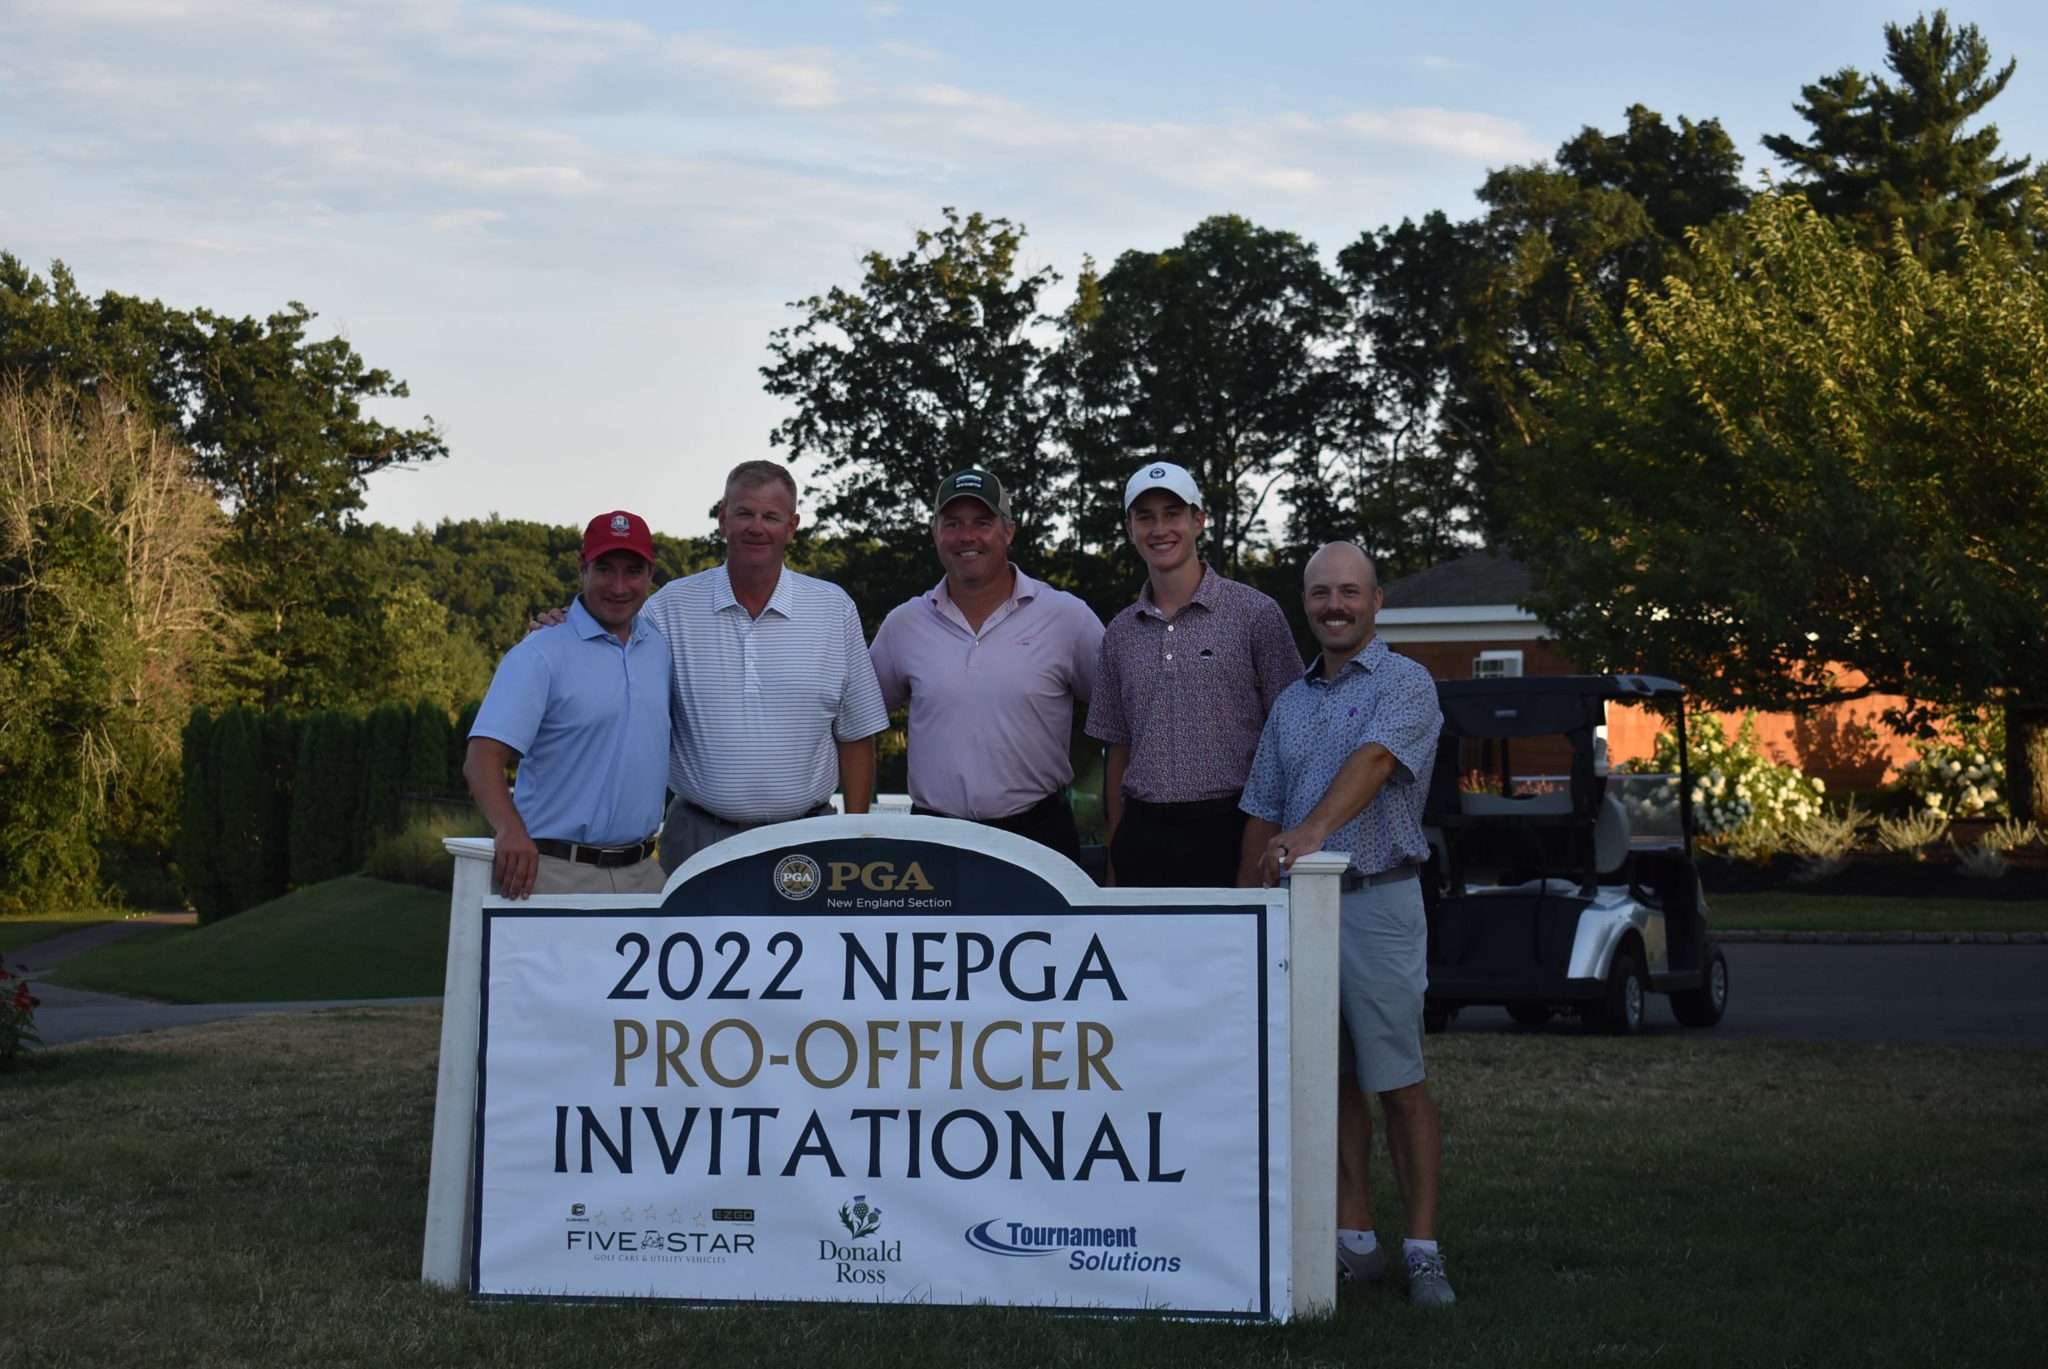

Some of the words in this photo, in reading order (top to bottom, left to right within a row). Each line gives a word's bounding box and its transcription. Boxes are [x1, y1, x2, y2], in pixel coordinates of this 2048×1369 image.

[782, 872, 813, 882] PGA
[827, 861, 934, 891] PGA
[827, 898, 852, 908] New
[856, 897, 904, 910] England
[907, 897, 952, 908] Section
[606, 931, 804, 1001] 2022
[839, 930, 1129, 1002] NEPGA
[613, 1018, 1124, 1092] PRO-OFFICER
[554, 1105, 1186, 1183] INVITATIONAL
[567, 1230, 638, 1252] FIVE
[667, 1232, 755, 1254] STAR
[1006, 1222, 1138, 1248] Tournament
[594, 1254, 615, 1262] GOLF
[618, 1254, 639, 1262] CARS
[650, 1255, 683, 1263] UTILITY
[686, 1256, 726, 1264] VEHICLES
[819, 1239, 902, 1263] Donald
[1068, 1250, 1182, 1273] Solutions
[836, 1262, 886, 1284] Ross
